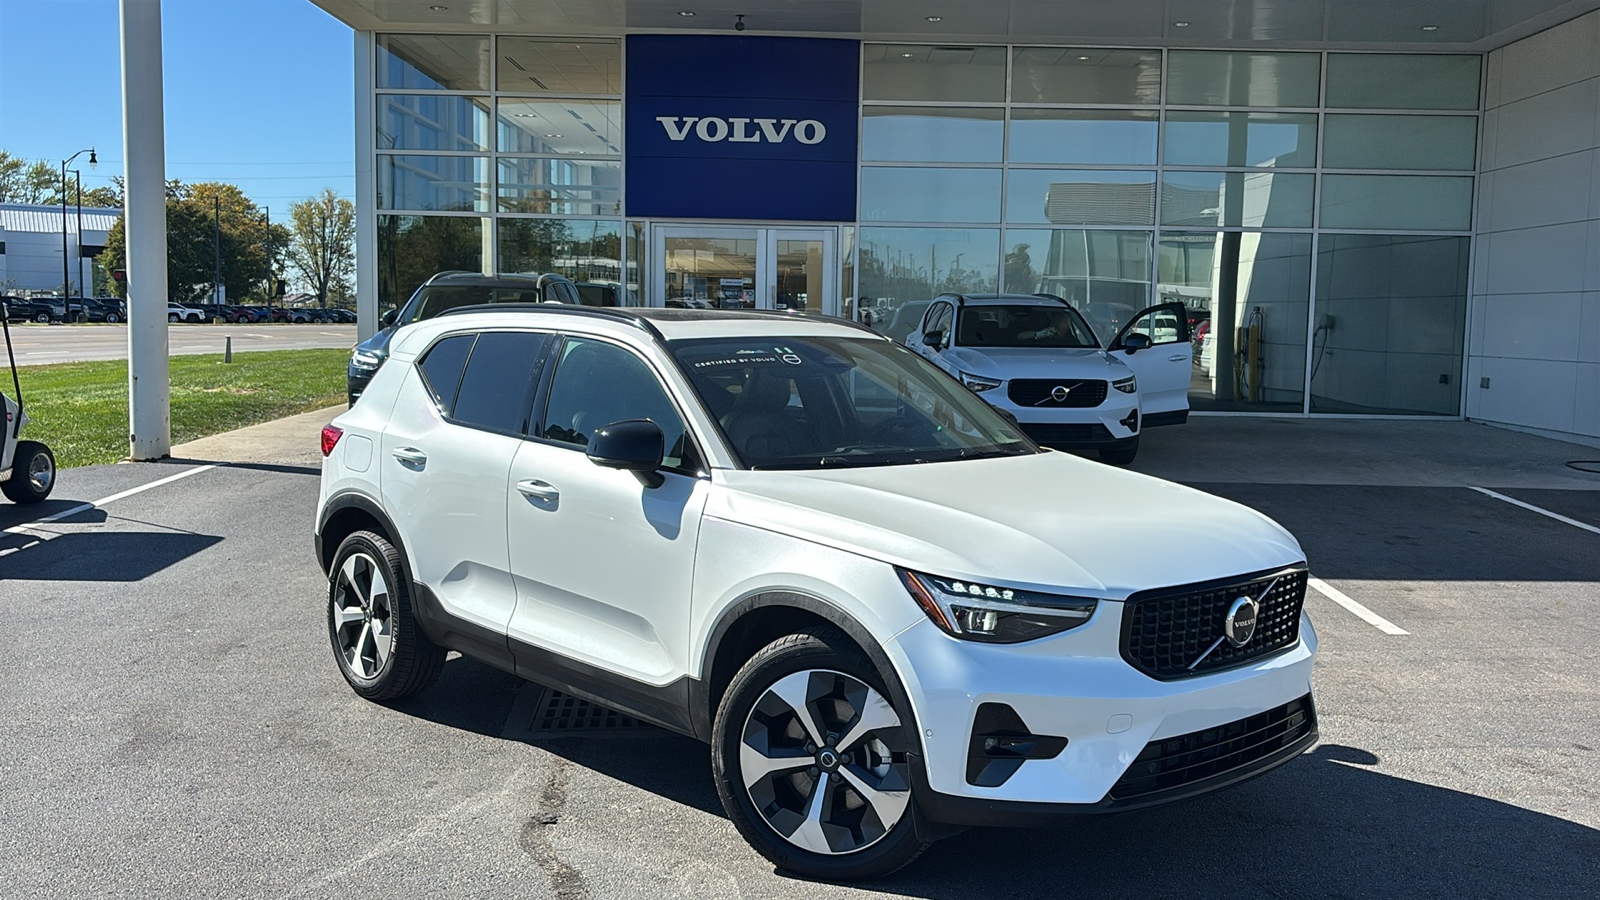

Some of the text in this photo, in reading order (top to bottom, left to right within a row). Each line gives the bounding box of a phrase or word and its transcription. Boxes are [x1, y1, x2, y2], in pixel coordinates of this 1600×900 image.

[656, 116, 826, 145] VOLVO
[694, 359, 737, 368] CERTIFIED
[1234, 618, 1255, 628] VOLVO
